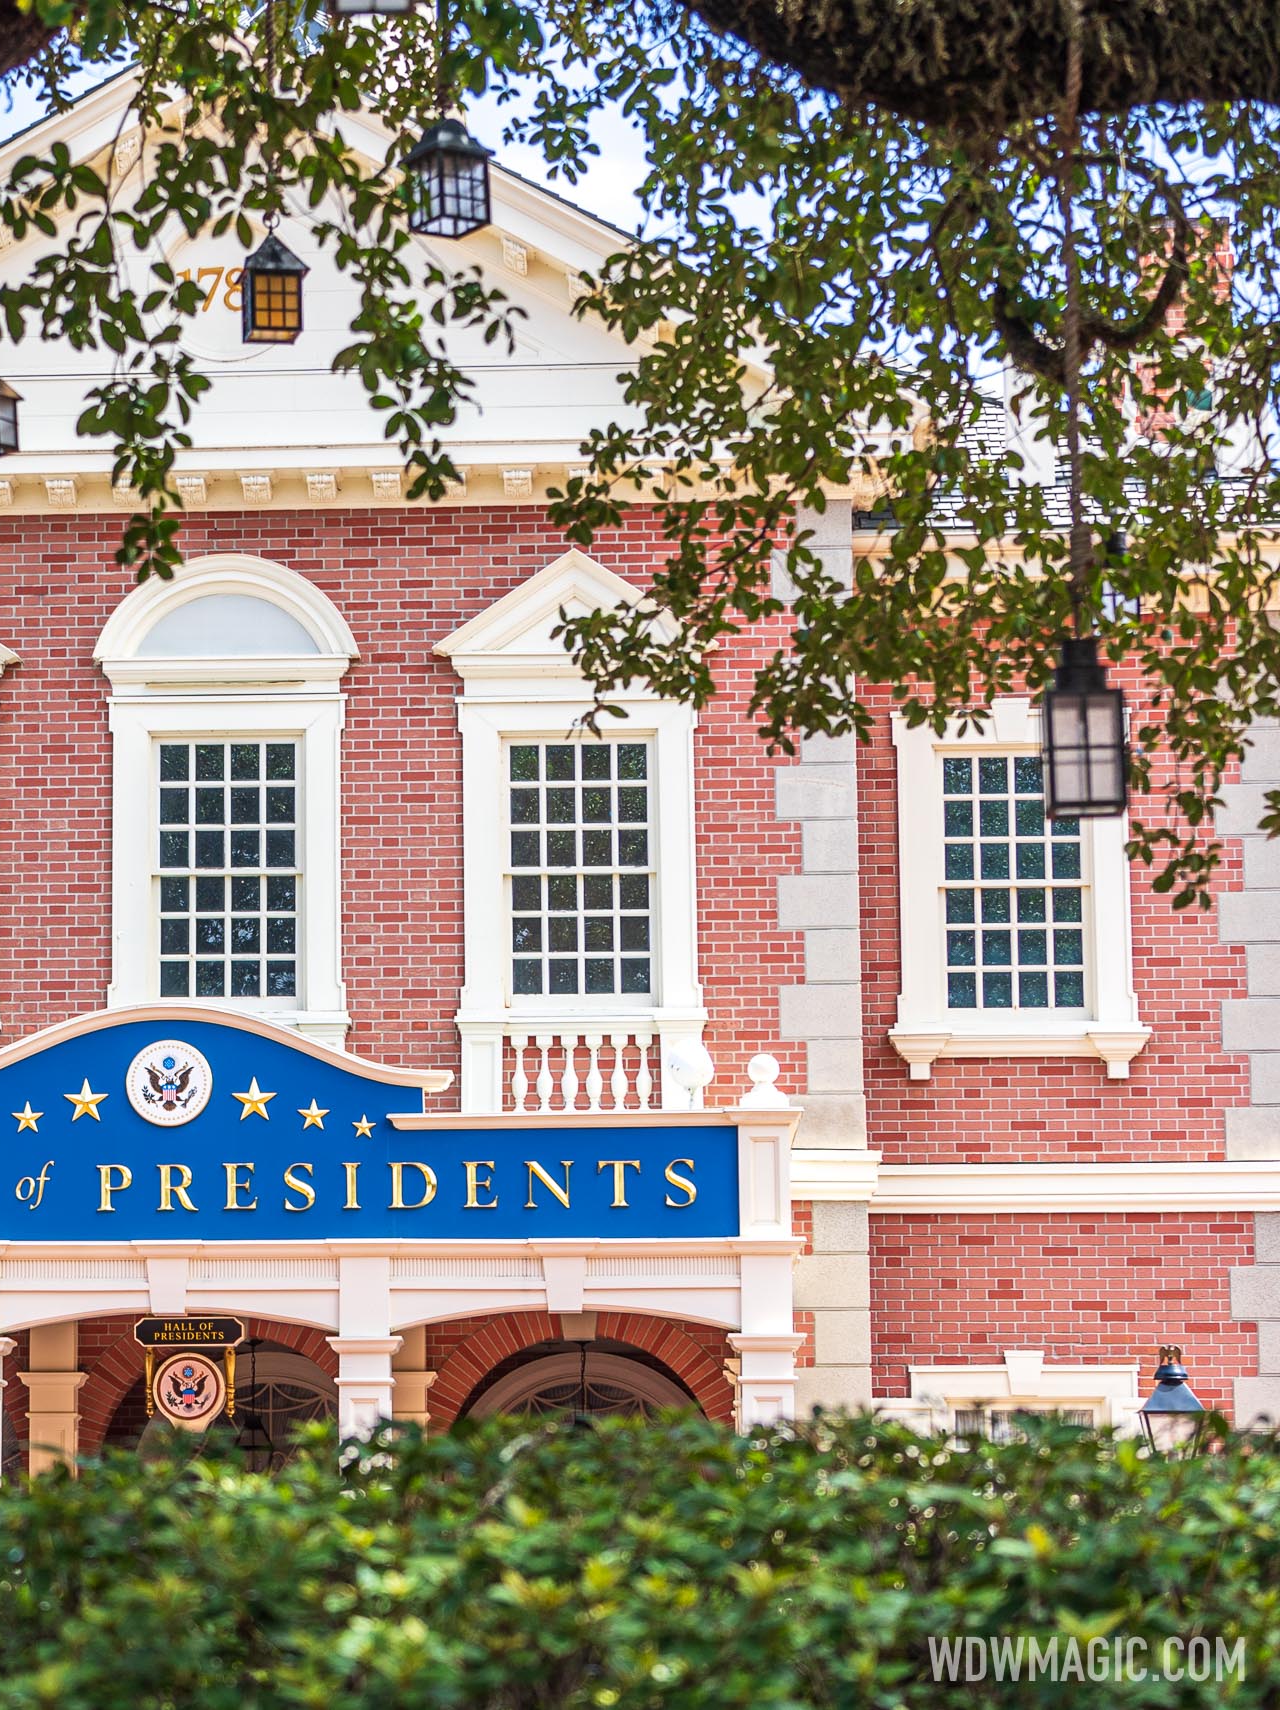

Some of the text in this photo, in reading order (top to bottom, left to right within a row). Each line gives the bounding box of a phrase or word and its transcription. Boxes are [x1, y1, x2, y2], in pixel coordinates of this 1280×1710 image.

[14, 1160, 55, 1210] of
[96, 1159, 698, 1212] PRESIDENTS
[163, 1321, 214, 1331] HALL OF
[154, 1331, 225, 1341] PRESIDENTS
